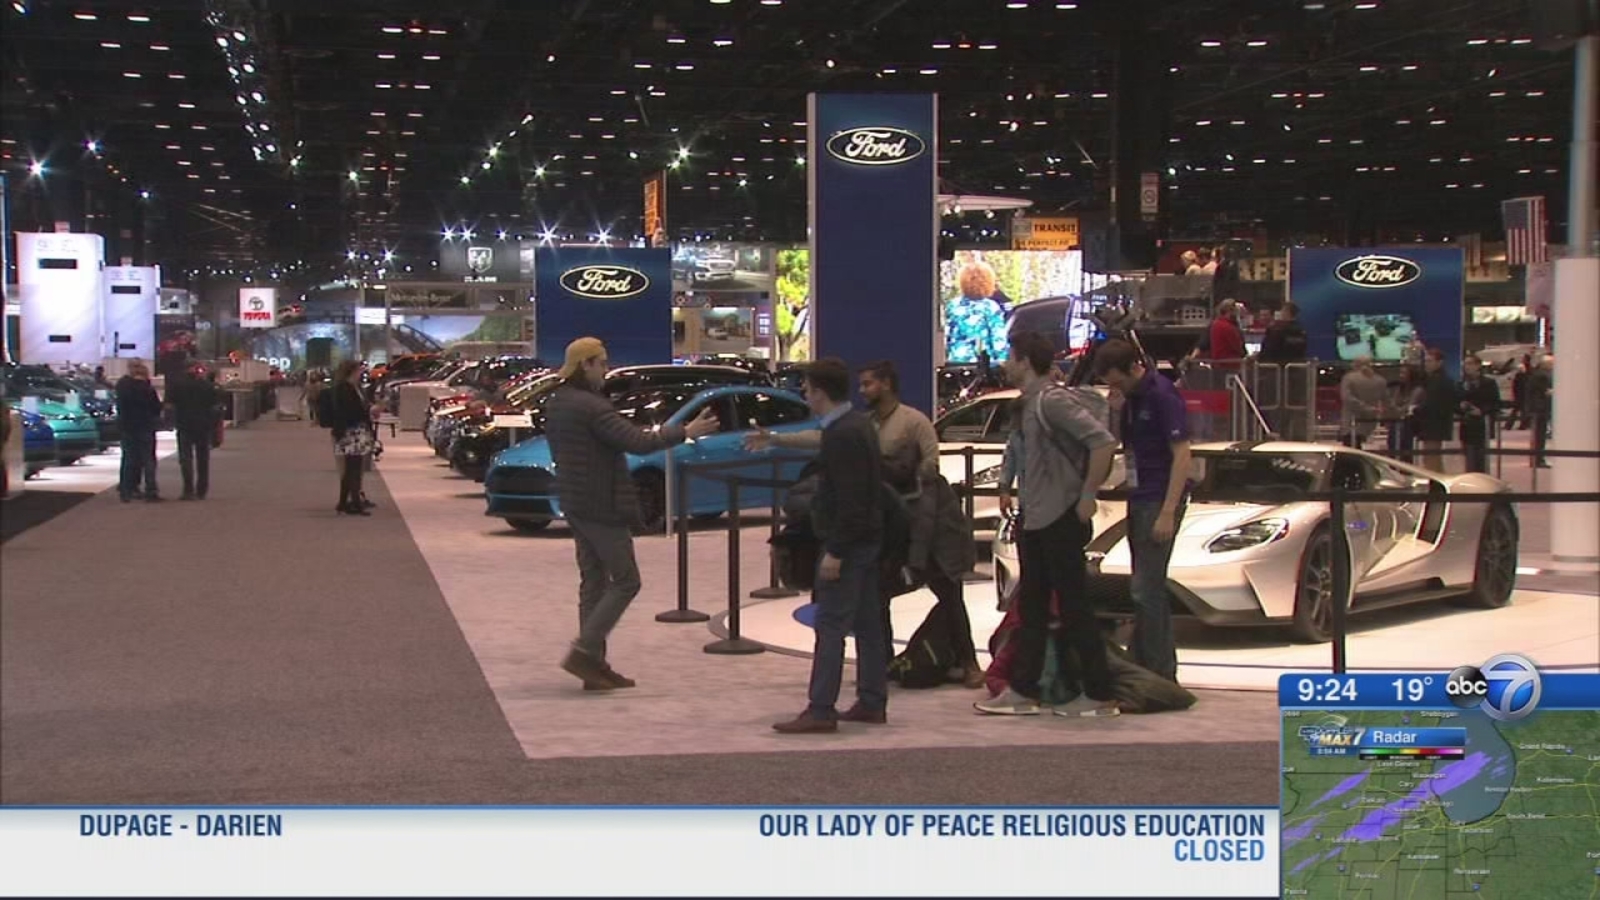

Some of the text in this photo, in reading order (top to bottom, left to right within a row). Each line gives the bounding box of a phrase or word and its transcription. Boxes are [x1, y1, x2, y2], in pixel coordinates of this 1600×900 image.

[845, 131, 907, 157] Ford
[1034, 223, 1077, 232] TRANSIT
[577, 268, 632, 291] Ford
[1352, 259, 1406, 282] Ford
[243, 312, 271, 321] TOYOTA
